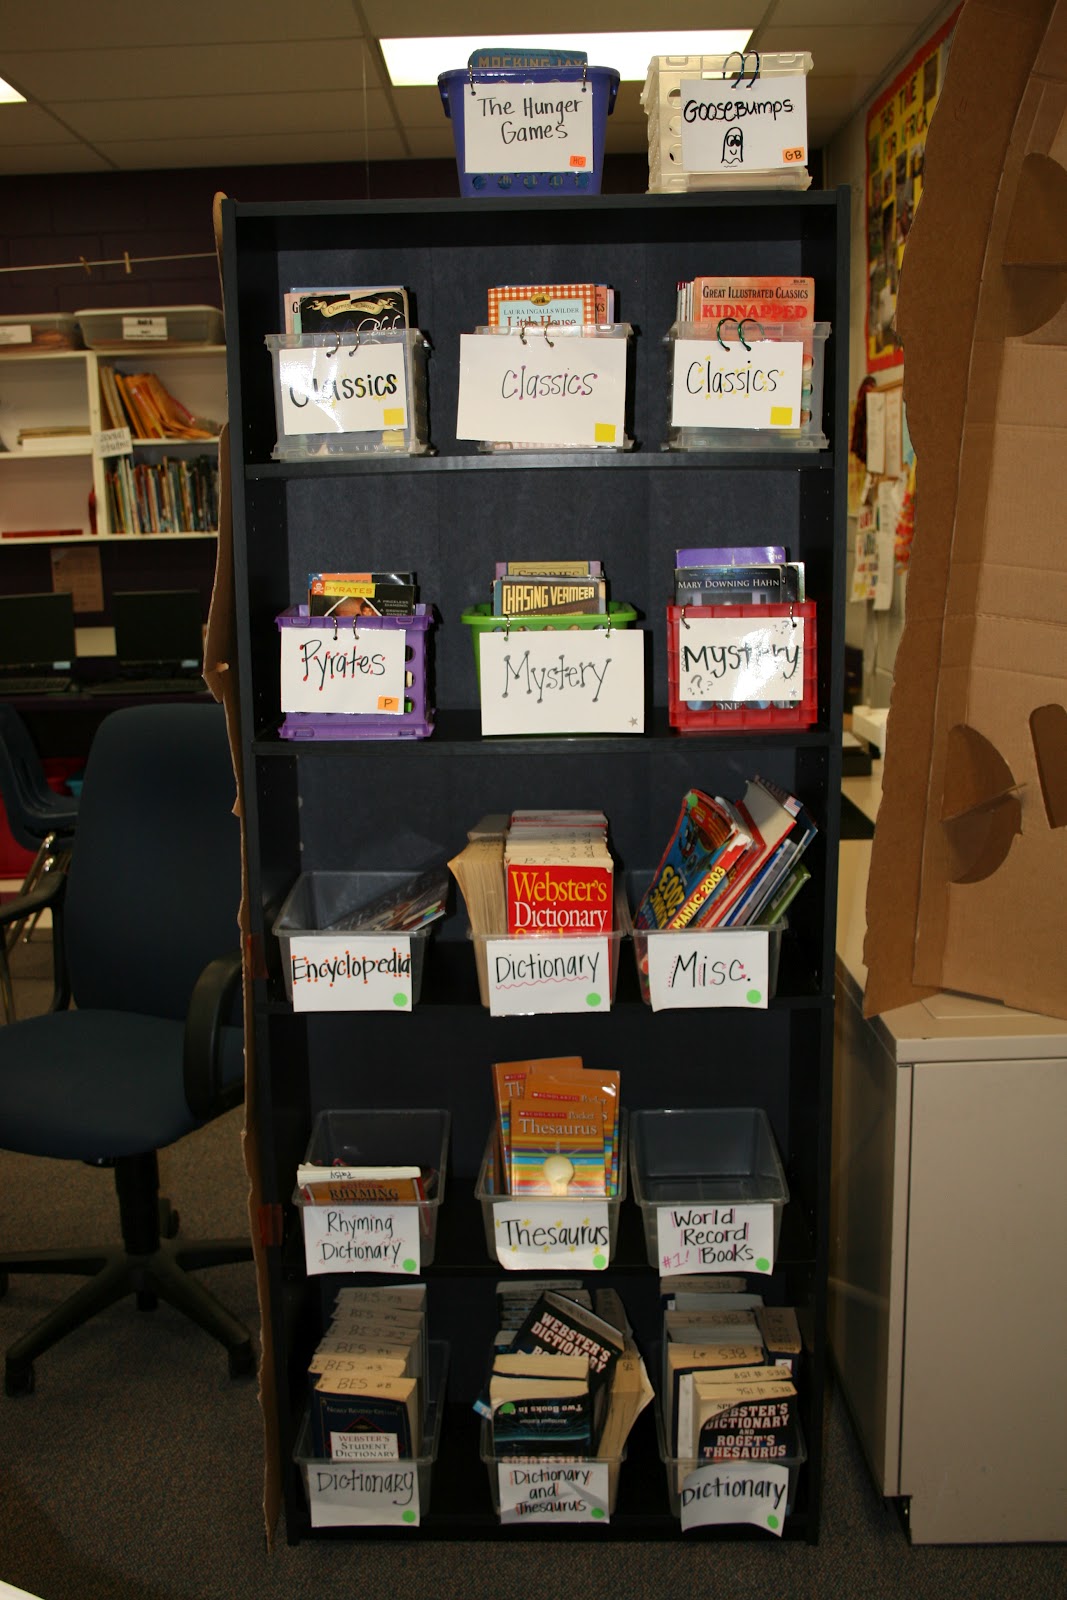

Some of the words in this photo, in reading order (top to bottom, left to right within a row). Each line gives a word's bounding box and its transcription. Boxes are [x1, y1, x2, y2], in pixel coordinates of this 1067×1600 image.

[477, 97, 514, 118] The
[523, 97, 583, 125] Hunger
[500, 121, 569, 144] Games
[786, 149, 802, 162] GB
[703, 286, 726, 299] GREAT
[728, 287, 774, 299] ILLUSTRATED
[776, 286, 809, 299] CLASSICS
[541, 315, 577, 326] House
[702, 304, 808, 319] KIDNAPPED
[501, 364, 598, 400] Classics
[686, 360, 780, 394] Classics
[289, 373, 398, 408] Classics
[325, 584, 373, 594] PYRATES
[678, 581, 702, 590] MARY
[705, 579, 750, 589] DOWNING
[753, 579, 780, 588] HAHN
[502, 585, 549, 614] CHASING
[551, 586, 595, 605] VERMEER
[300, 640, 386, 691] Pyrates
[502, 650, 612, 703] Mystery
[384, 699, 393, 708] P
[511, 871, 607, 902] Webster's
[700, 865, 726, 895] 2003
[514, 901, 608, 932] Dictionary
[292, 948, 412, 987] Encyclopedia
[495, 952, 600, 984] Dictionary
[671, 951, 752, 988] Misc.
[568, 1112, 595, 1120] Pocket
[519, 1118, 597, 1135] Thesaurus
[329, 1188, 399, 1199] RHYMING
[327, 1211, 393, 1239] Rhyming
[673, 1208, 734, 1227] World
[501, 1219, 609, 1247] Thesaurus
[683, 1222, 748, 1246] Record
[321, 1241, 402, 1264] Dictionary
[662, 1250, 690, 1269] #1!
[539, 1312, 611, 1363] WEBSTER'S
[325, 1360, 355, 1371] BES
[337, 1378, 368, 1389] BES
[531, 1405, 560, 1414] Books
[562, 1404, 582, 1413] Two
[713, 1403, 788, 1419] EBSTER'S
[705, 1413, 790, 1430] DICTIONARY
[341, 1442, 387, 1450] STUDENT
[716, 1435, 775, 1446] ROGET'S
[335, 1449, 395, 1458] DICTIONARY
[704, 1445, 787, 1458] THESAURUS
[513, 1467, 590, 1485] Dictionary
[529, 1484, 557, 1499] and
[682, 1476, 786, 1510] Dictionary
[517, 1500, 587, 1515] Thesaurus
